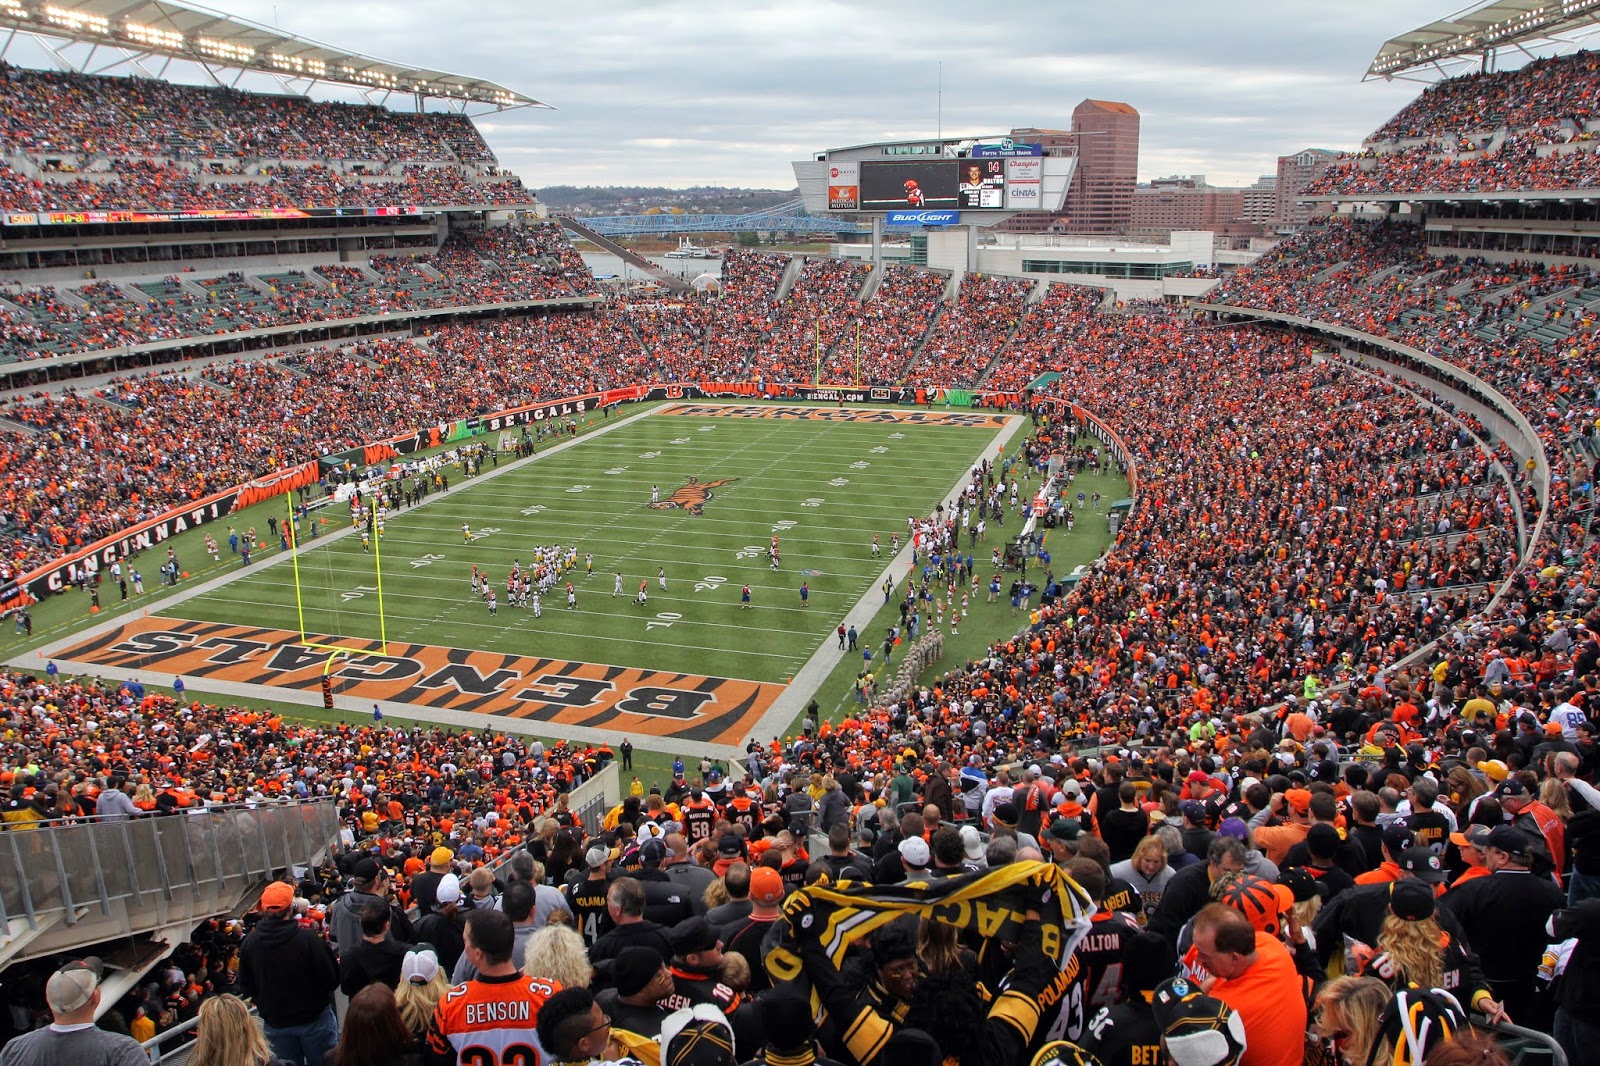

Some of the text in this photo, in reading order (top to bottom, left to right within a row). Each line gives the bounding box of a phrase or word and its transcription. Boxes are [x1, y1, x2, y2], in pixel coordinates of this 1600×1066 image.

[988, 161, 1000, 173] 14
[1009, 160, 1039, 168] Champion
[1011, 187, 1037, 197] CINTAS
[873, 389, 887, 398] 25
[47, 503, 219, 591] CINCINNATI
[736, 545, 766, 560] 30
[409, 553, 446, 569] 20
[694, 576, 728, 592] 20
[340, 585, 378, 602] 10
[646, 612, 683, 631] 10
[108, 630, 719, 721] BENGALS
[691, 821, 710, 839] 58
[1078, 933, 1120, 952] ALTON
[1037, 952, 1080, 1013] POLAMALU
[712, 983, 734, 1002] 18
[466, 1001, 530, 1025] BENSON
[1046, 981, 1084, 1042] 43
[1131, 1045, 1160, 1066] BET
